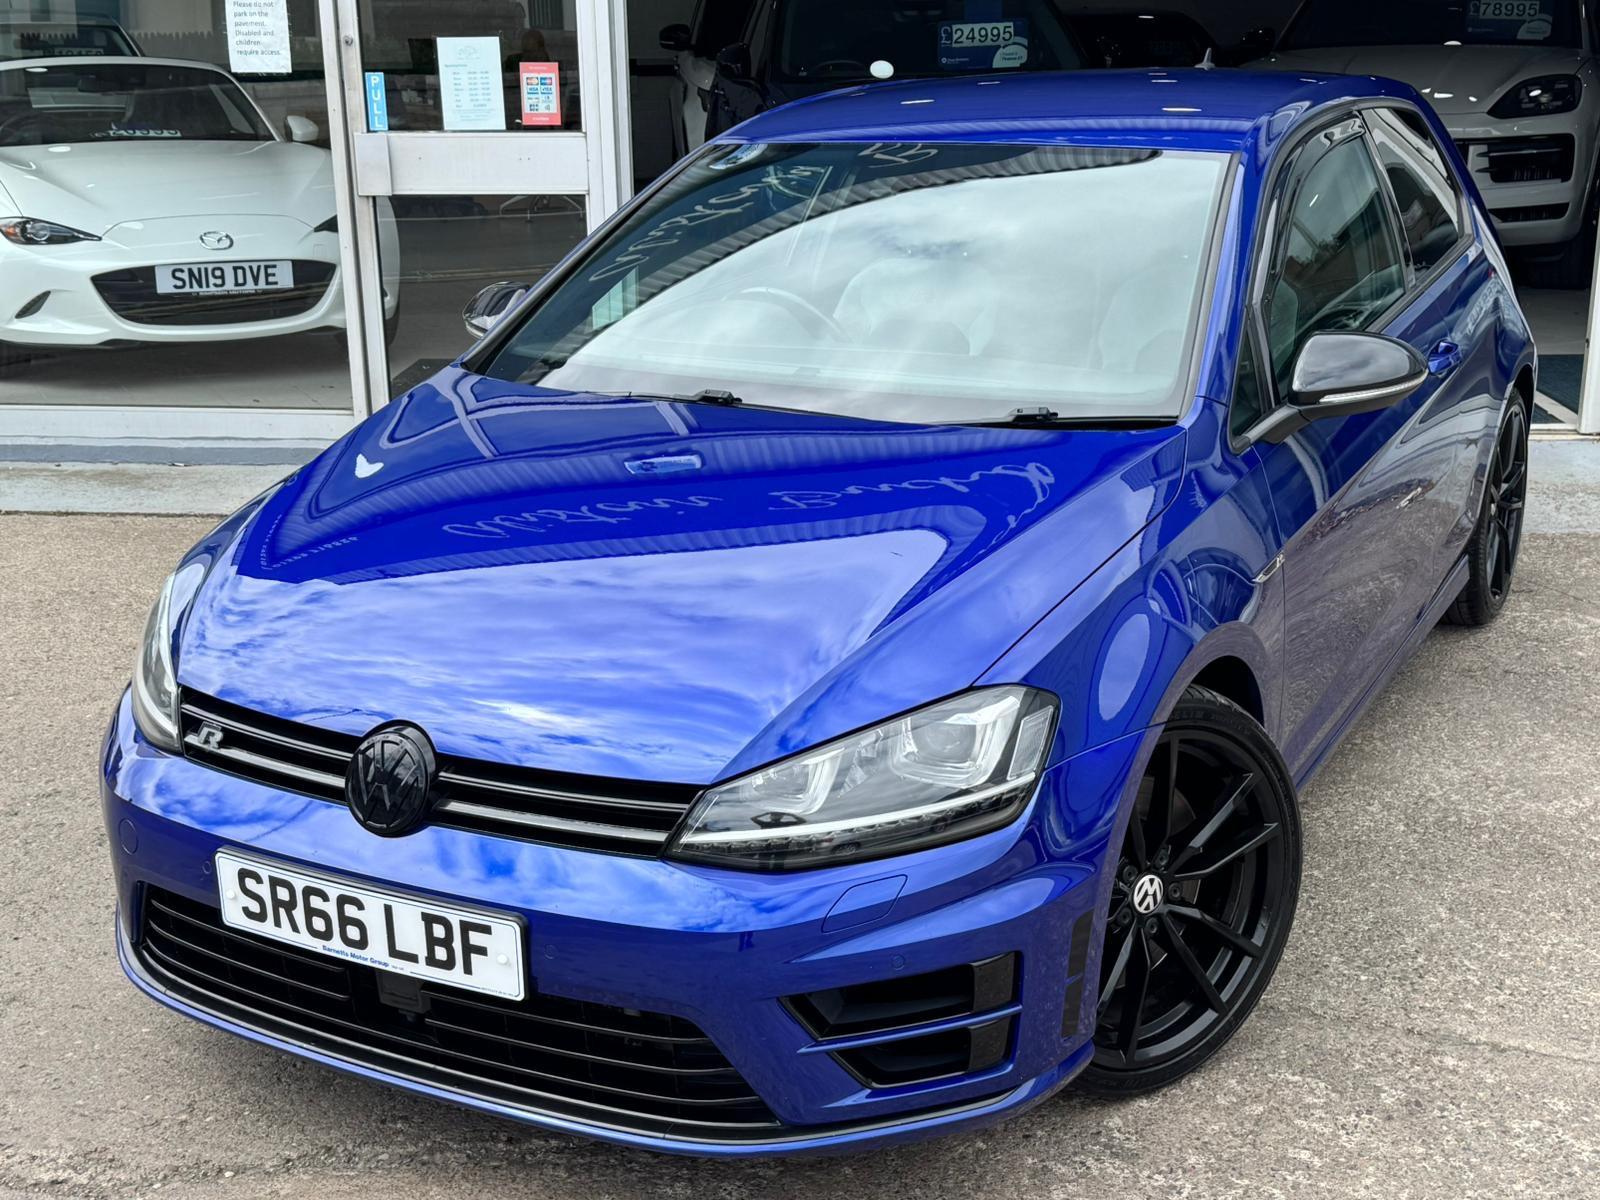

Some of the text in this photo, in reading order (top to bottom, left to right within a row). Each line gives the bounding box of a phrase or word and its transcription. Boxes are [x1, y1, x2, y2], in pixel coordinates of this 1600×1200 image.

[370, 76, 383, 128] PULL
[171, 264, 278, 290] SN19 DVE
[237, 867, 492, 975] SR66 LBF
[322, 944, 349, 957] Barnetts
[350, 952, 369, 962] Motor
[370, 957, 389, 968] Group
